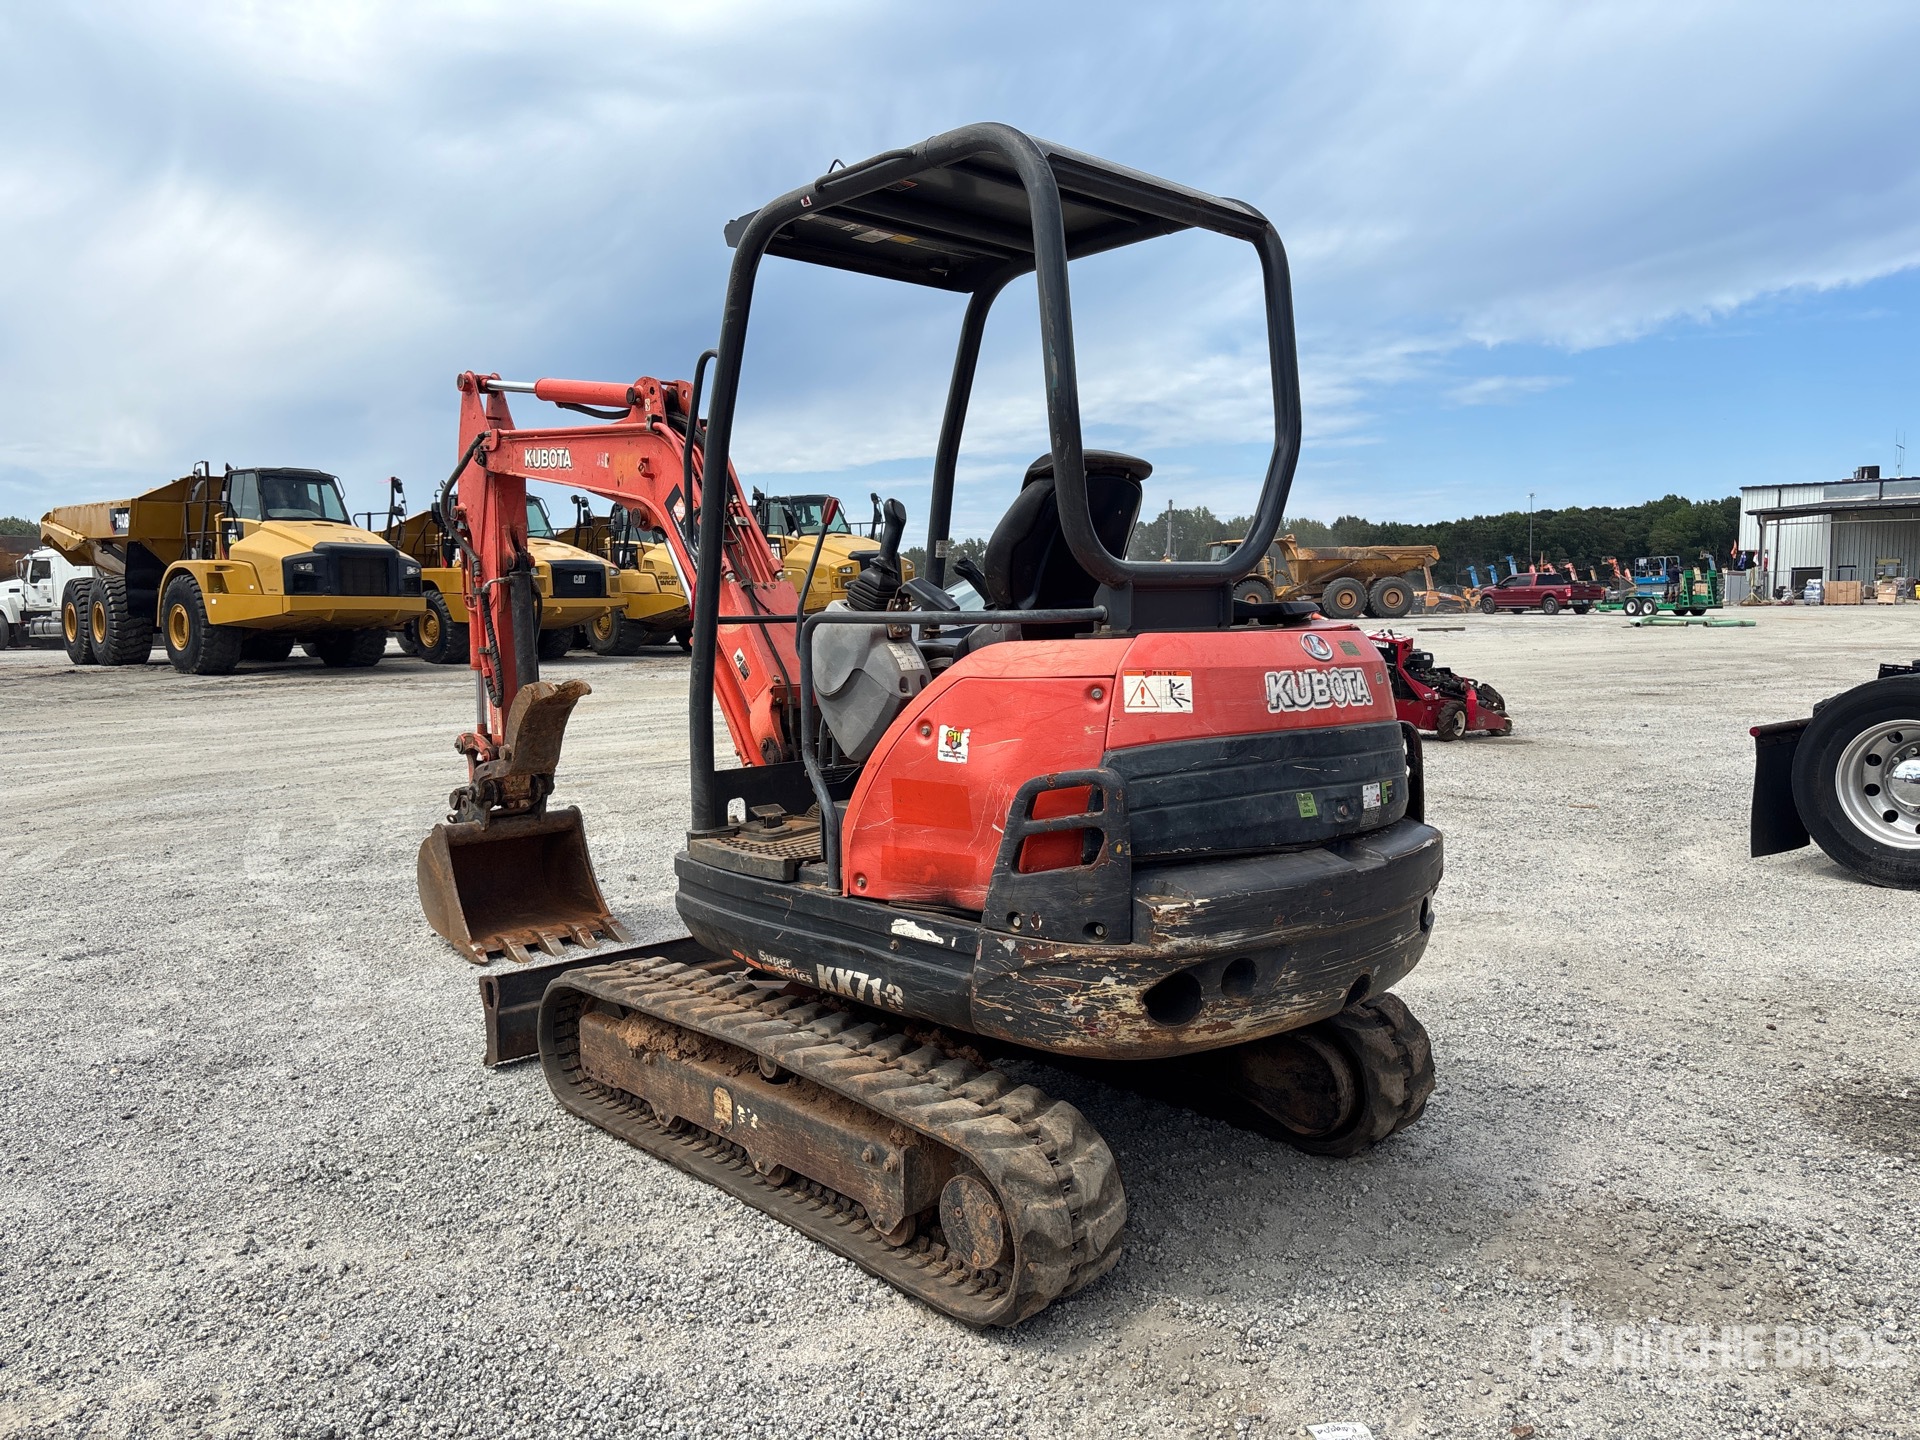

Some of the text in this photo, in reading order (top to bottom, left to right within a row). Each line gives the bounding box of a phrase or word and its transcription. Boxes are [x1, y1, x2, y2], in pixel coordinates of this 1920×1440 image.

[523, 448, 573, 468] KUBOTA
[114, 513, 130, 529] 740B
[573, 574, 587, 584] CAT
[1266, 668, 1372, 711] KUBOTA
[758, 949, 792, 968] Super
[776, 965, 813, 984] Series
